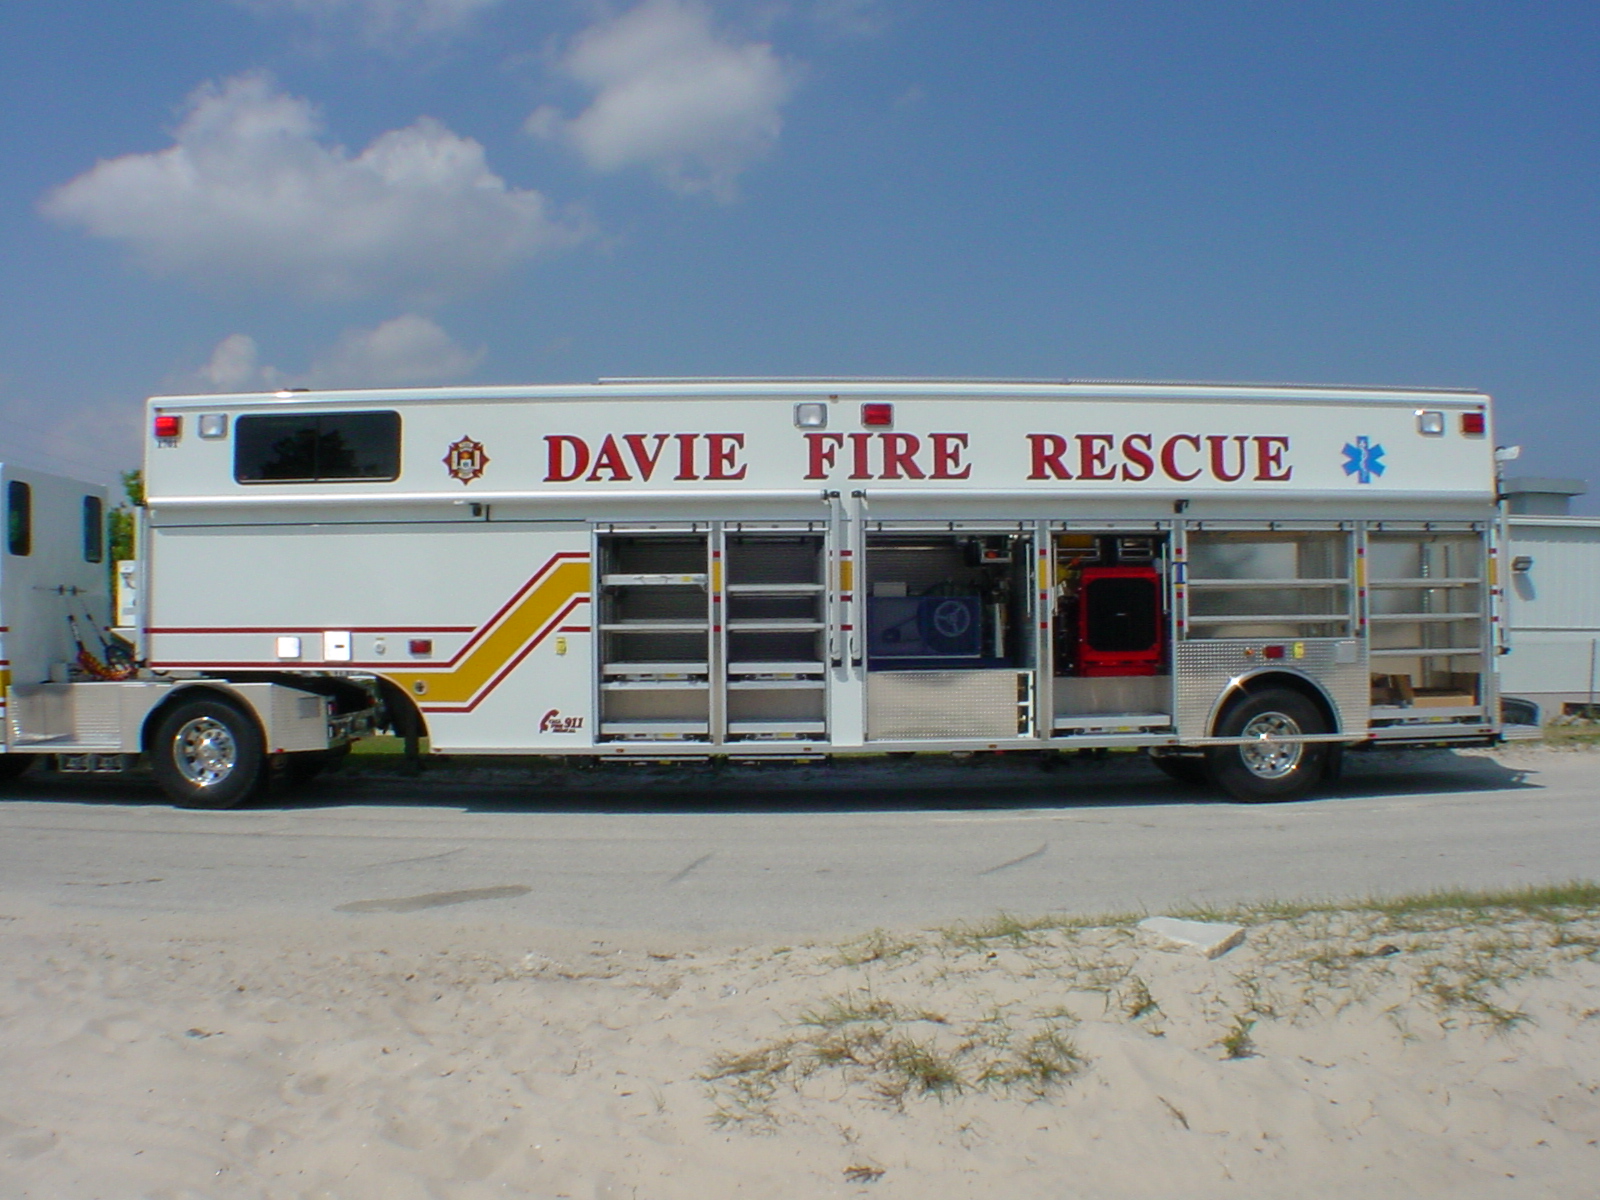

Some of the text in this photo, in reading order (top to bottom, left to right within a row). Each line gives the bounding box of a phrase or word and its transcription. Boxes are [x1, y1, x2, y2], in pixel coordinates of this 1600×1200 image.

[543, 433, 1292, 482] DAVIE FIRE RESCUE
[564, 717, 584, 729] 911
